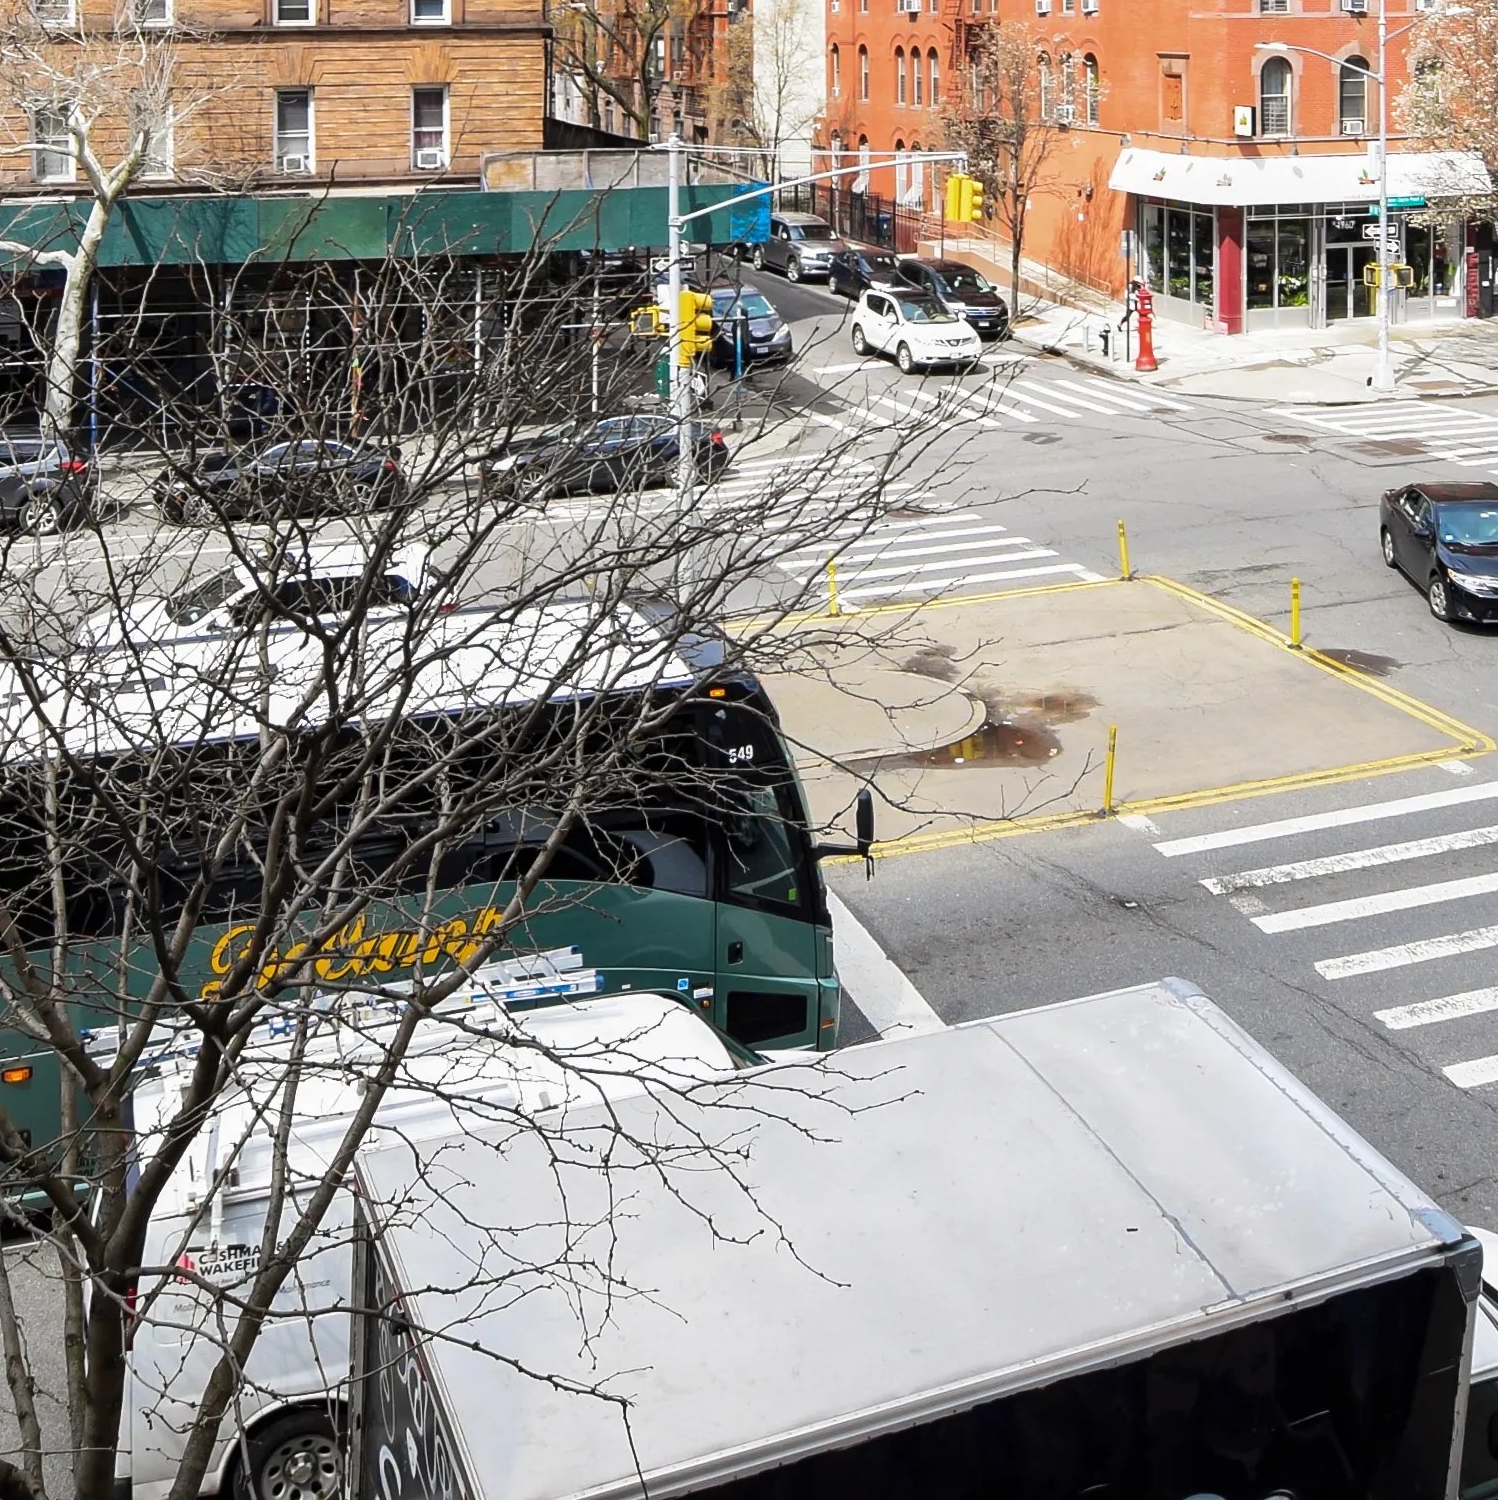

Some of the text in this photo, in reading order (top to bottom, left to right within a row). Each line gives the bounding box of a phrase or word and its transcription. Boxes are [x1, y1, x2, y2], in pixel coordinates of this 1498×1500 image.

[728, 744, 754, 764] 549
[198, 1244, 264, 1265] CSHMA
[200, 1256, 262, 1277] WAKEFI
